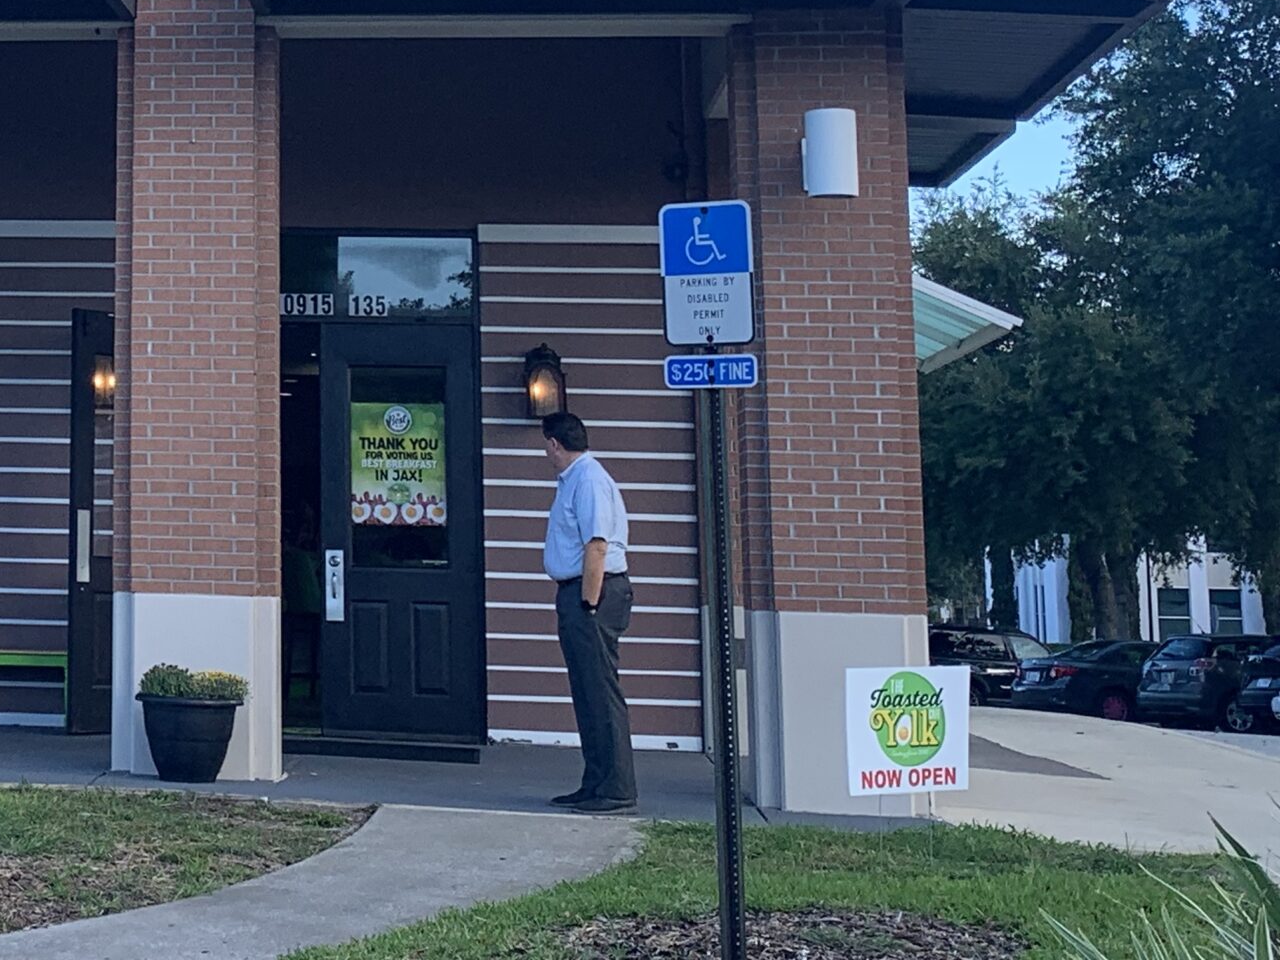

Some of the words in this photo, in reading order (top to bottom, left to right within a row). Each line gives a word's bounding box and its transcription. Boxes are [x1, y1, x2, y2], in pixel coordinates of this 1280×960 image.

[680, 277, 718, 287] PARKING
[723, 276, 735, 286] BY
[283, 294, 332, 314] 0915
[351, 295, 386, 315] 135
[687, 293, 729, 304] DISABLED
[693, 309, 724, 319] PERMIT
[698, 326, 721, 336] ONLY
[719, 361, 753, 381] FINE
[359, 437, 406, 450] THANK
[409, 438, 439, 451] YOU
[365, 451, 384, 460] FOR
[386, 451, 419, 460] VOTING
[361, 459, 383, 468] BEST
[385, 460, 437, 469] BREAKFAST
[375, 470, 388, 481] IN
[392, 470, 423, 482] JAX!
[870, 688, 943, 709] Toasted
[869, 708, 939, 748] Yolk
[861, 770, 902, 789] NOW
[908, 767, 956, 787] OPEN
